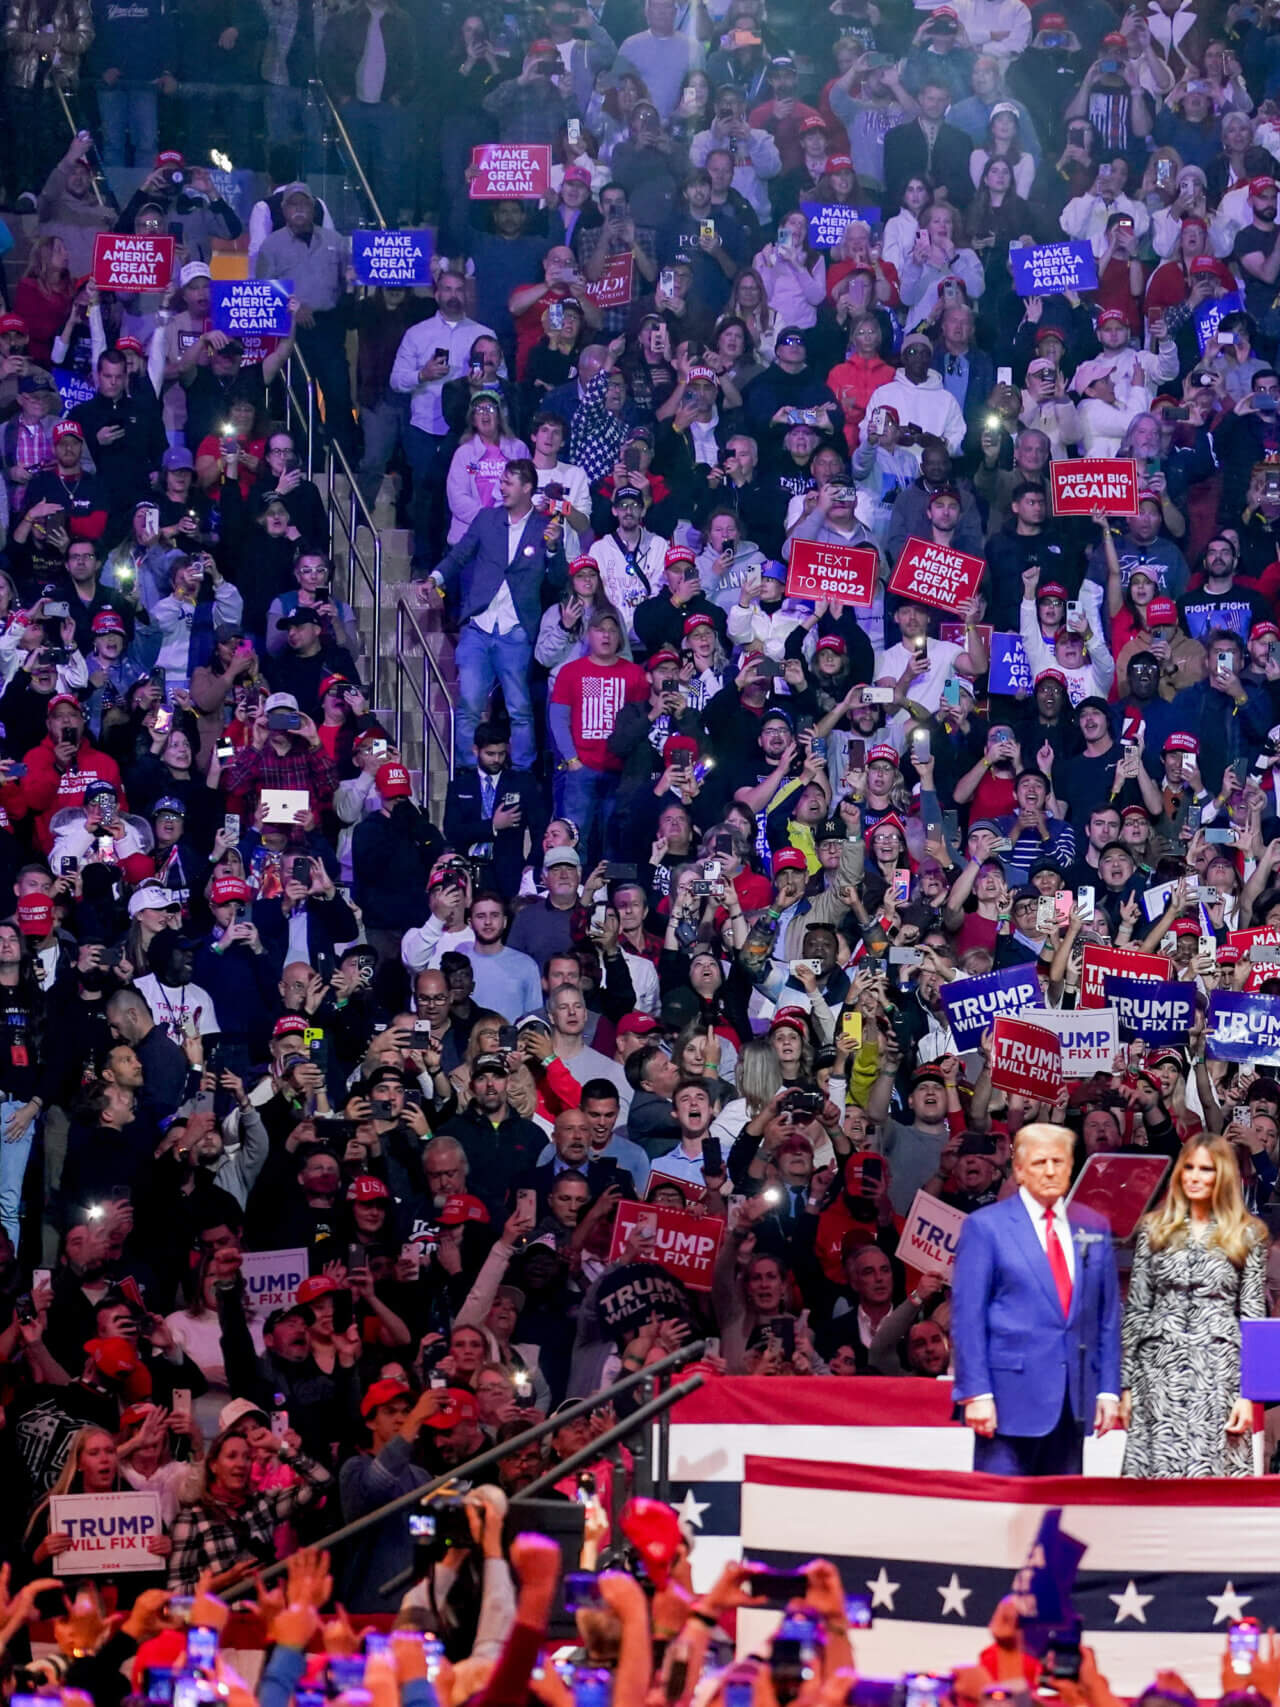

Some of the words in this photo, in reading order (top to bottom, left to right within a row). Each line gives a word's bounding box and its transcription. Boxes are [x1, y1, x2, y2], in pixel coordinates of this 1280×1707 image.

[491, 150, 529, 160] MAKE
[479, 160, 540, 171] AMERICA
[487, 171, 532, 181] GREAT
[486, 181, 533, 192] AGAIN!
[821, 208, 858, 219] MAKE
[817, 227, 844, 236] GRE
[115, 240, 154, 251] MAKE
[374, 236, 412, 247] MAKE
[103, 250, 164, 263] AMERICA
[362, 247, 423, 258] AMERICA
[1032, 246, 1071, 259] MAKE
[110, 262, 157, 273] GREAT
[370, 258, 416, 269] GREAT
[1023, 255, 1083, 269] AMERICA
[368, 269, 416, 280] AGAIN!
[1032, 264, 1077, 277] GREAT
[108, 273, 157, 285] AGAIN!
[1033, 275, 1079, 289] AGAIN!
[232, 286, 271, 297] MAKE
[221, 296, 284, 307] AMERICA
[229, 307, 276, 318] GREAT
[229, 318, 277, 329] AGAIN!
[690, 367, 716, 379] TRUMP
[57, 423, 78, 434] MAGA
[1058, 474, 1104, 486] DREAM
[1107, 474, 1132, 487] BIG,
[1061, 485, 1127, 499] AGAIN!
[816, 552, 852, 568] TEXT
[925, 548, 963, 569] MAKE
[808, 564, 858, 581] TRUMP
[909, 555, 970, 584] AMERICA
[797, 575, 817, 589] TO
[820, 580, 865, 597] 88022
[913, 568, 960, 592] GREAT
[907, 579, 957, 604] AGAIN!
[1184, 603, 1216, 614] FIGHT
[1220, 601, 1250, 611] FIGHT
[603, 679, 613, 730] TRUMP
[949, 984, 1034, 1020] TRUMP
[1108, 995, 1190, 1019] TRUMP
[954, 1014, 990, 1032] WILL
[1142, 1020, 1168, 1031] FIX
[1172, 1020, 1188, 1031] IT
[1061, 1036, 1110, 1053] UMP
[997, 1038, 1062, 1069] TRUMP
[1069, 1053, 1092, 1064] FIX
[1097, 1053, 1110, 1064] IT
[997, 1056, 1026, 1076] WILL
[1029, 1067, 1050, 1081] FIX
[1051, 1071, 1063, 1086] IT
[621, 1221, 715, 1255] TUMP
[911, 1234, 942, 1262] WILL
[664, 1251, 691, 1267] FIX
[695, 1257, 711, 1270] IT
[250, 1273, 301, 1293] UMP
[259, 1292, 283, 1305] FIX
[287, 1291, 300, 1304] IT
[601, 1277, 678, 1313] TRUM
[605, 1300, 647, 1325] WILL
[64, 1515, 154, 1538] TRUMP
[110, 1536, 138, 1550] FIX
